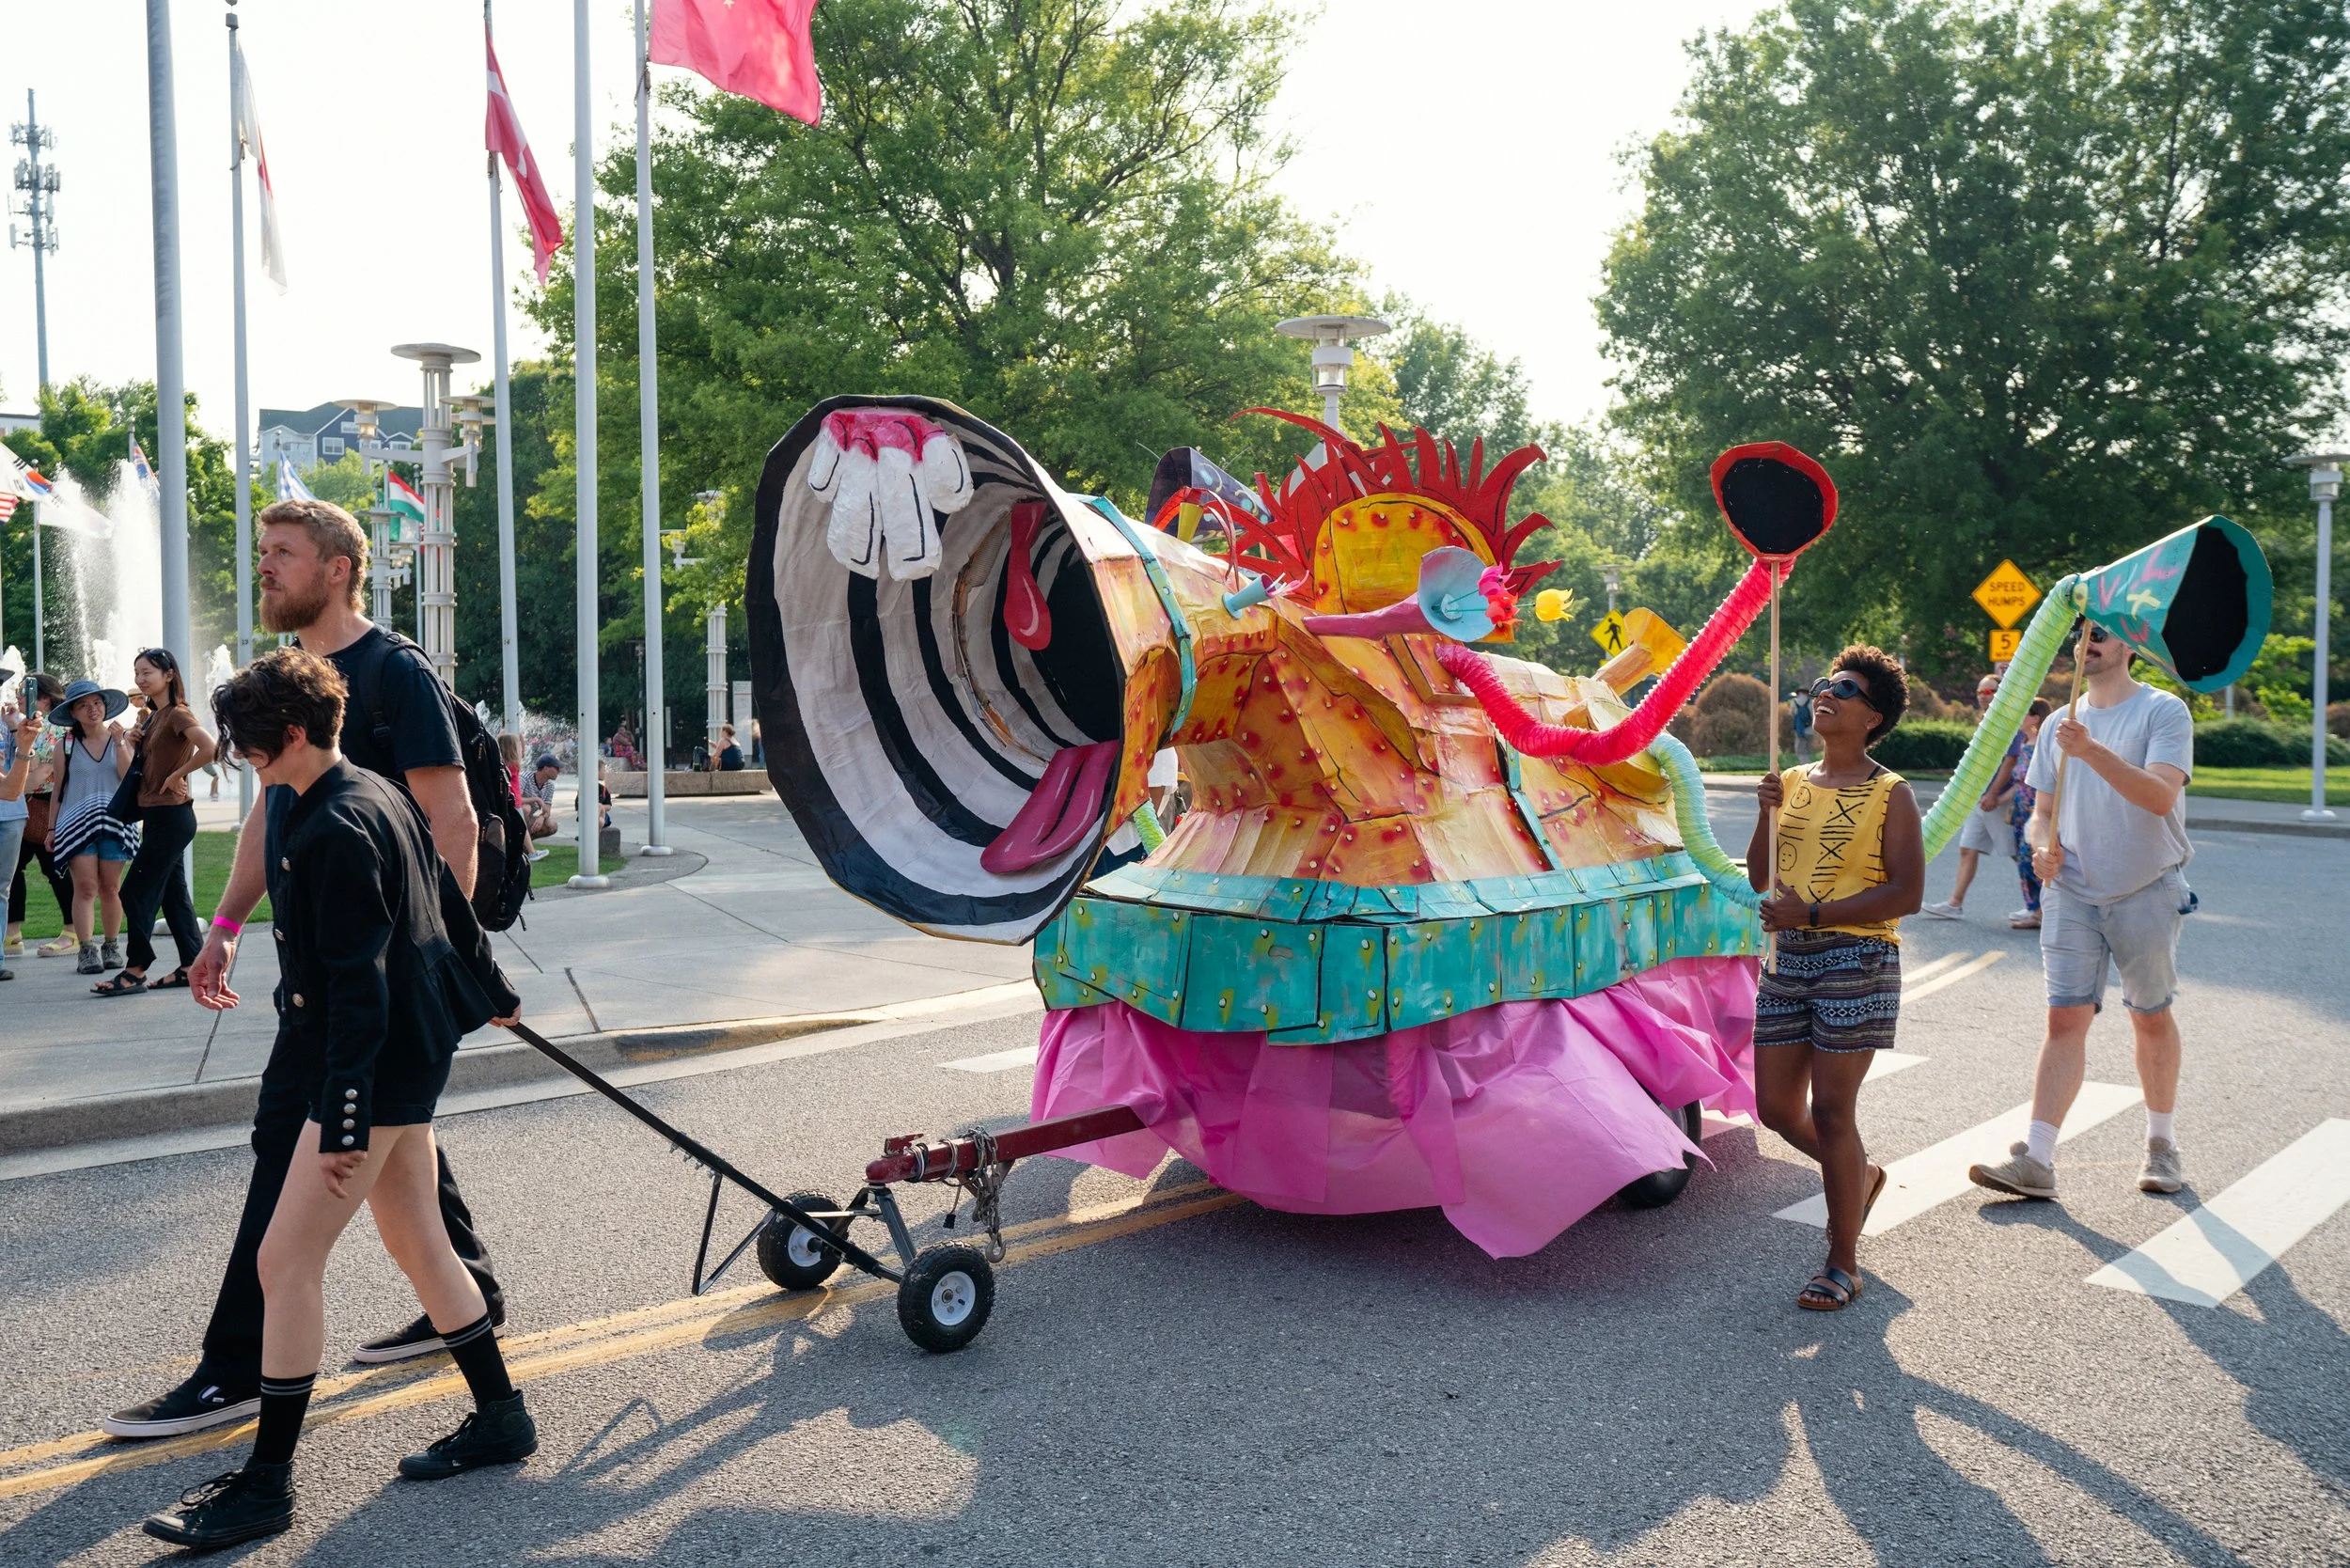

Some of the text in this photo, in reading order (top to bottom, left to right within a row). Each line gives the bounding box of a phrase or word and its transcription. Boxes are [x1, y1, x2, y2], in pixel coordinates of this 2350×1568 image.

[1989, 582, 2026, 591] SPEED
[1988, 597, 2026, 606] HUMPS
[2001, 634, 2011, 650] 5
